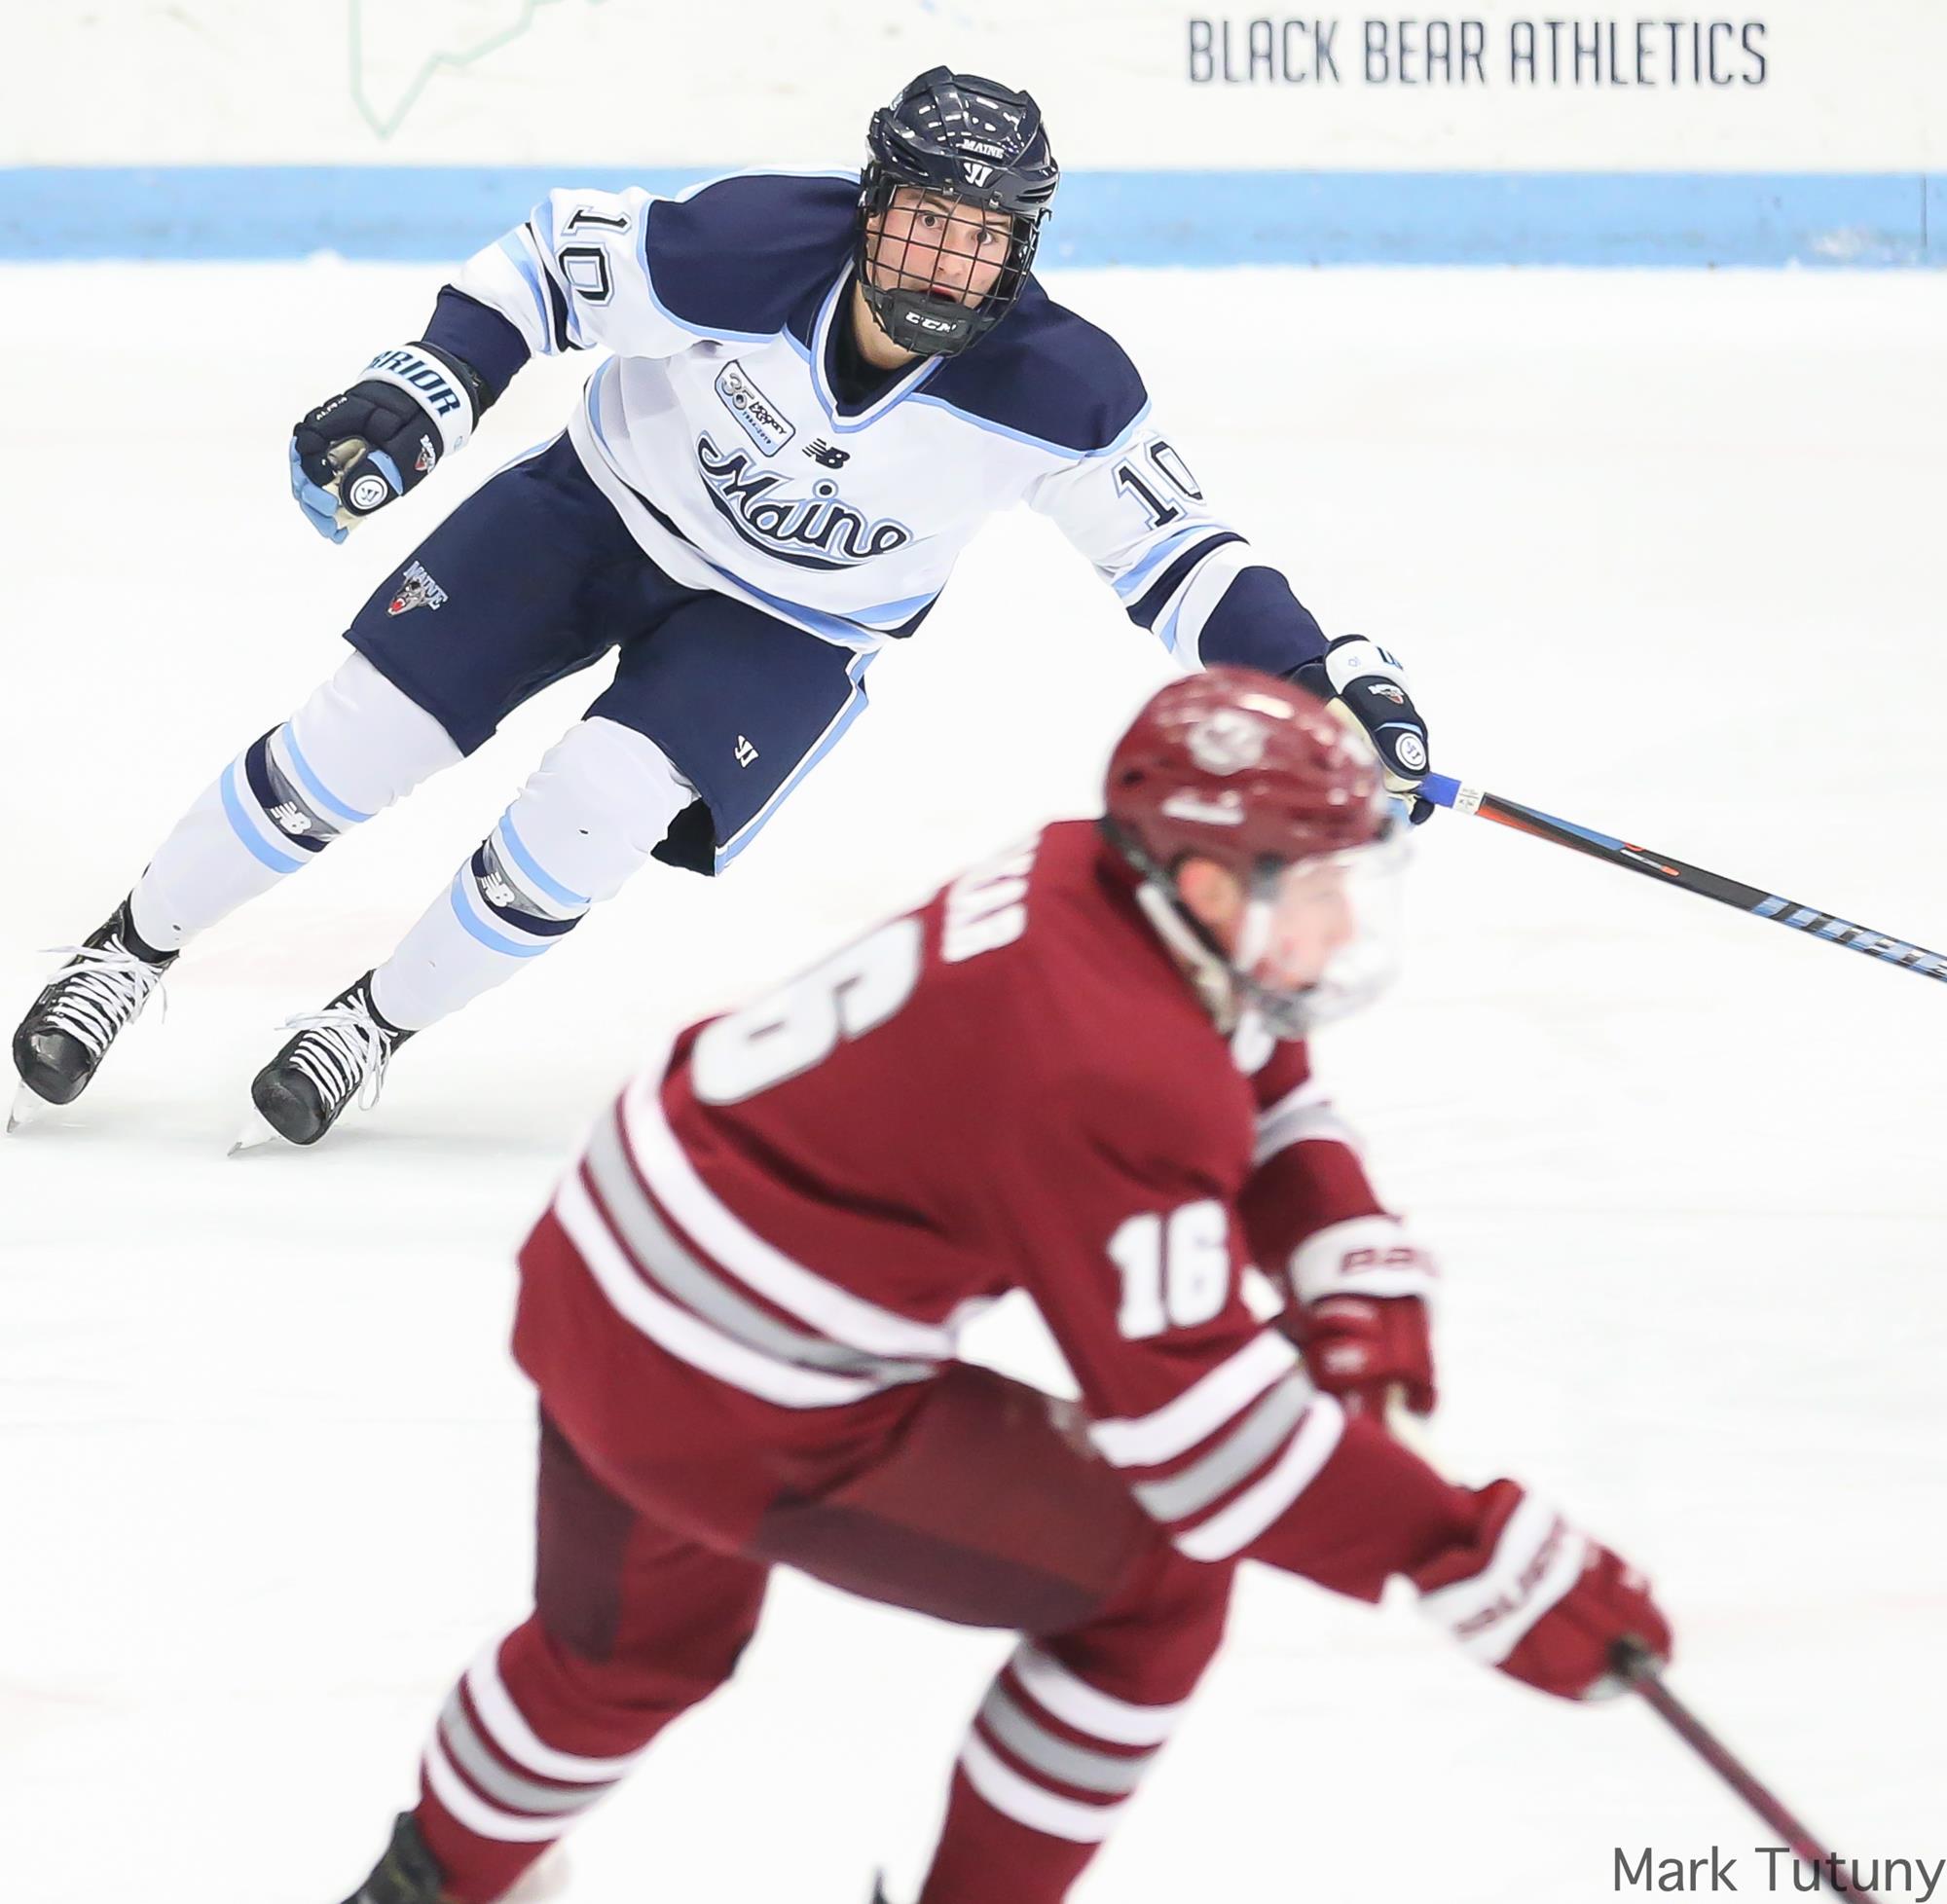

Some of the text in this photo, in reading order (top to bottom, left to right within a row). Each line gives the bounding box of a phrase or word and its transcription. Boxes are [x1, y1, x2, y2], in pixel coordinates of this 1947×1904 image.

[1189, 19, 1768, 86] BLACK BEAR ATHLETICS
[961, 138, 1006, 160] MAINE
[556, 205, 632, 306] 10
[697, 434, 910, 562] Maine
[1114, 437, 1206, 530] 10
[1107, 1198, 1231, 1340] 16
